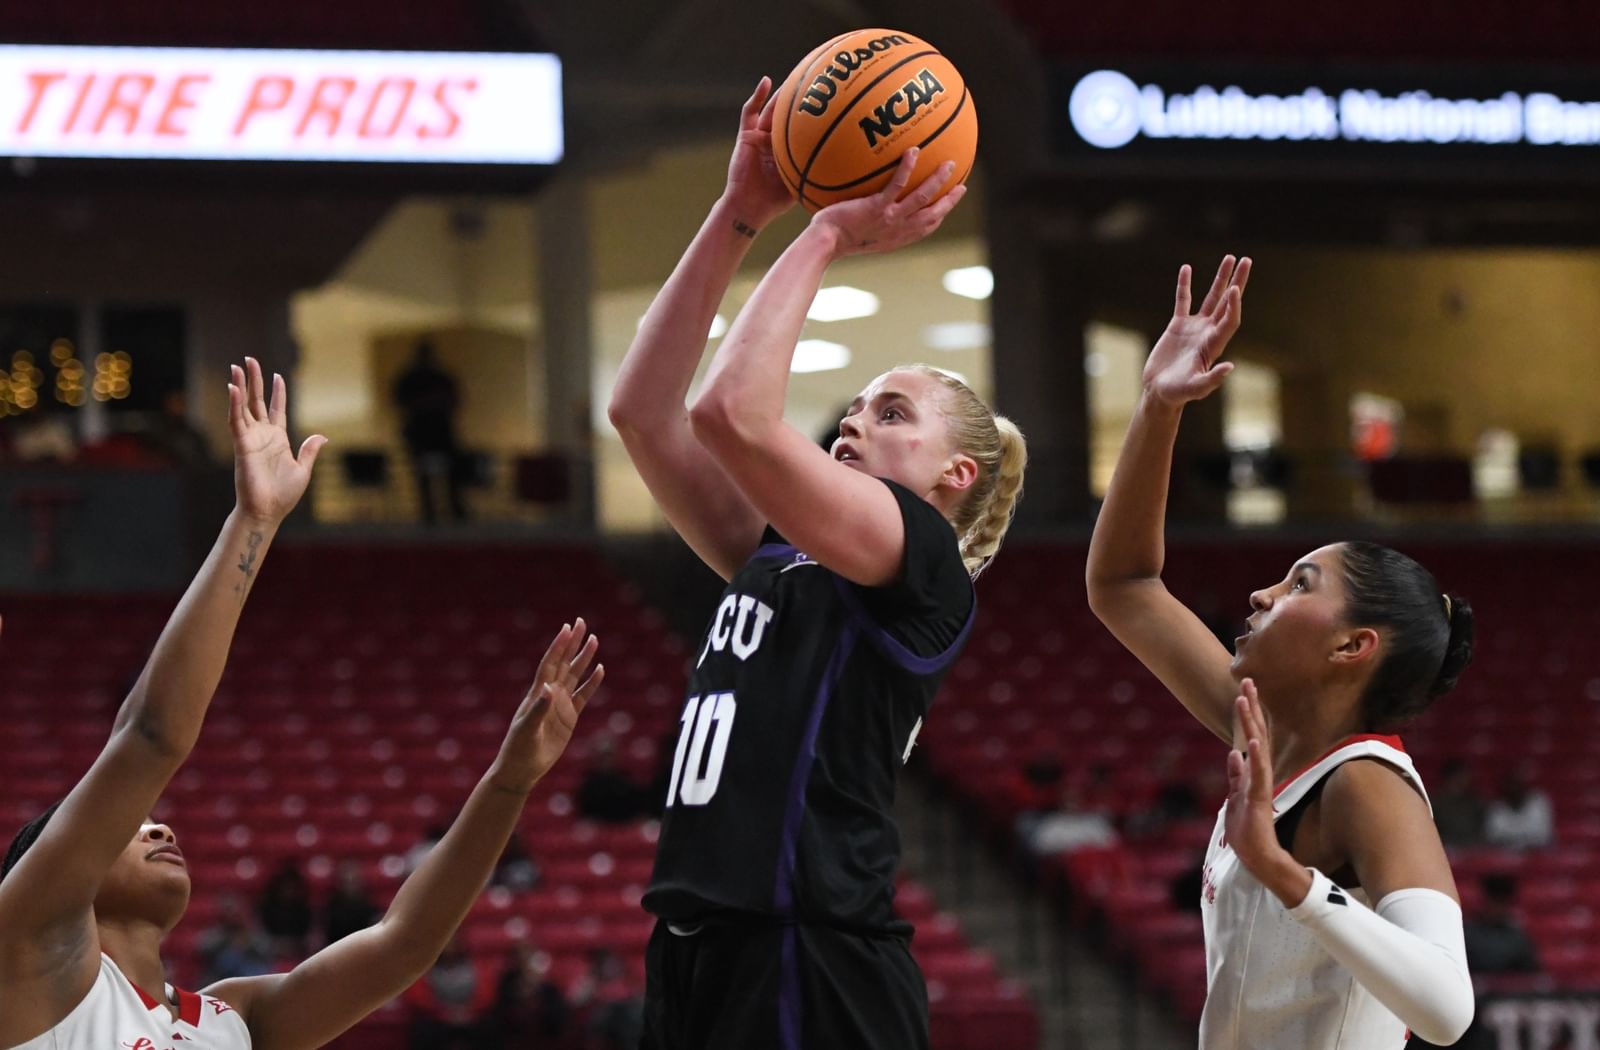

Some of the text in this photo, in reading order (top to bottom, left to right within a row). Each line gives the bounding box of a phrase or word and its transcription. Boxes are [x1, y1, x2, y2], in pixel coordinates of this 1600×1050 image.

[16, 71, 480, 140] TIRE PROS
[798, 33, 915, 117] Wilson
[858, 67, 945, 148] NCAA
[697, 593, 775, 669] CU
[665, 689, 737, 808] 10
